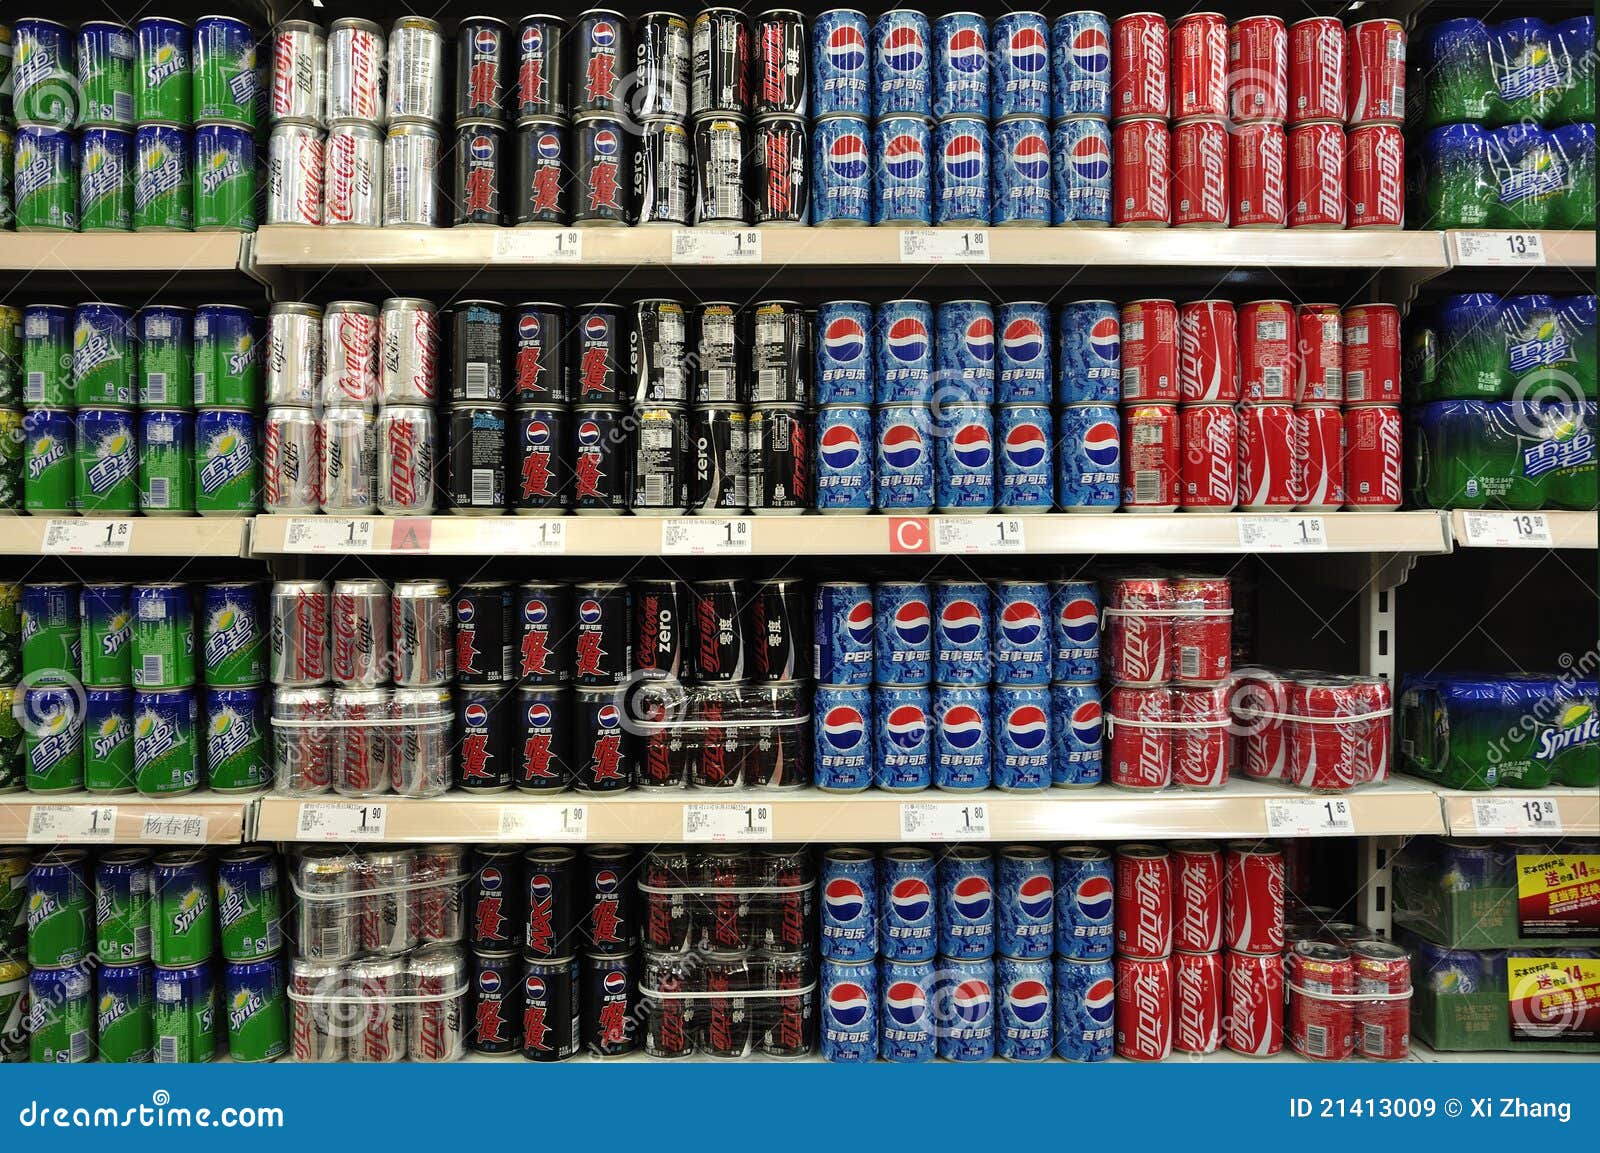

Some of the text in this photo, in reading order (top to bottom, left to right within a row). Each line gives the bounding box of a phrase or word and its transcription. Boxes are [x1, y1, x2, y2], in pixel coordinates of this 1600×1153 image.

[148, 55, 185, 88] Sprite
[636, 43, 646, 89] zero
[1318, 22, 1343, 115] 可口可乐
[229, 69, 256, 105] 雪
[824, 79, 866, 93] 百事可乐
[881, 79, 925, 93] 百事可乐
[945, 80, 987, 94] 百事可乐
[1006, 80, 1048, 93] 百事可乐
[1069, 80, 1110, 93] 百事可乐
[202, 159, 241, 194] Sprite
[355, 158, 372, 196] light
[634, 151, 643, 195] zero
[1145, 126, 1166, 220] 可口可乐
[1200, 125, 1224, 219] 可口可乐
[1261, 128, 1284, 221] 可口可乐
[1317, 126, 1342, 221] 可口可乐
[1375, 127, 1401, 221] 可口可乐
[827, 187, 869, 199] 百事可乐
[882, 187, 925, 199] 百事可乐
[942, 187, 985, 199] 百事可乐
[1011, 187, 1050, 201] 百事可乐
[1069, 187, 1110, 199] 百事可乐
[271, 337, 284, 372] light
[339, 308, 368, 400] Coca-Cola
[630, 331, 638, 375] zero
[1181, 309, 1201, 398] 可口可乐
[823, 369, 865, 381] 百事可乐
[886, 369, 929, 381] 百事可乐
[1002, 369, 1044, 381] 百事可乐
[29, 445, 65, 479] Sprite
[328, 441, 343, 478] light
[698, 437, 708, 481] zero
[1207, 406, 1231, 502] 可口可乐
[1286, 408, 1310, 501] Coca-Cola
[1525, 431, 1595, 477] 雪碧
[201, 443, 251, 494] 雪碧
[819, 475, 862, 487] 百事可乐
[880, 475, 924, 487] 百事可乐
[951, 475, 992, 487] 百事可乐
[1003, 475, 1047, 487] 百事可乐
[1081, 473, 1120, 485] 百事可乐
[399, 527, 419, 549] A
[897, 521, 922, 549] C
[103, 628, 132, 654] Spri
[356, 617, 374, 654] light
[402, 617, 420, 655] light
[659, 609, 671, 653] zero
[844, 652, 873, 664] PEP
[892, 651, 930, 662] 百事可乐
[940, 651, 984, 662] 百事可乐
[1000, 651, 1042, 662] 百事可乐
[1059, 648, 1099, 659] 百事可乐
[94, 721, 131, 758] Sprite
[1536, 717, 1600, 759] Sprite
[822, 755, 864, 766] 百事可乐
[885, 755, 927, 766] 百事可乐
[940, 755, 983, 766] 百事可乐
[1006, 755, 1047, 766] 百事可乐
[144, 816, 200, 838] 杨春鹤
[1545, 870, 1560, 887] 送
[1571, 861, 1589, 879] 14
[174, 895, 207, 935] Sprite
[1135, 861, 1162, 954] 可口可乐
[1180, 858, 1208, 948] 可口可乐
[27, 901, 56, 931] Sprite
[530, 897, 553, 954] MAX
[824, 926, 865, 939] 百事可乐
[889, 925, 931, 938] 百事可乐
[951, 925, 992, 937] 百事可乐
[1016, 924, 1053, 936] 百事可乐
[1074, 925, 1114, 937] 百事可乐
[1536, 973, 1553, 990] 送
[1564, 965, 1582, 983] 14
[231, 995, 261, 1033] Sprite
[1134, 970, 1161, 1057] 可口可乐
[1178, 966, 1204, 1050] 可口可乐
[827, 1030, 869, 1042] 百事可乐
[885, 1030, 927, 1042] 百事可乐
[950, 1029, 992, 1041] 百事可乐
[1007, 1029, 1049, 1041] 百事可乐
